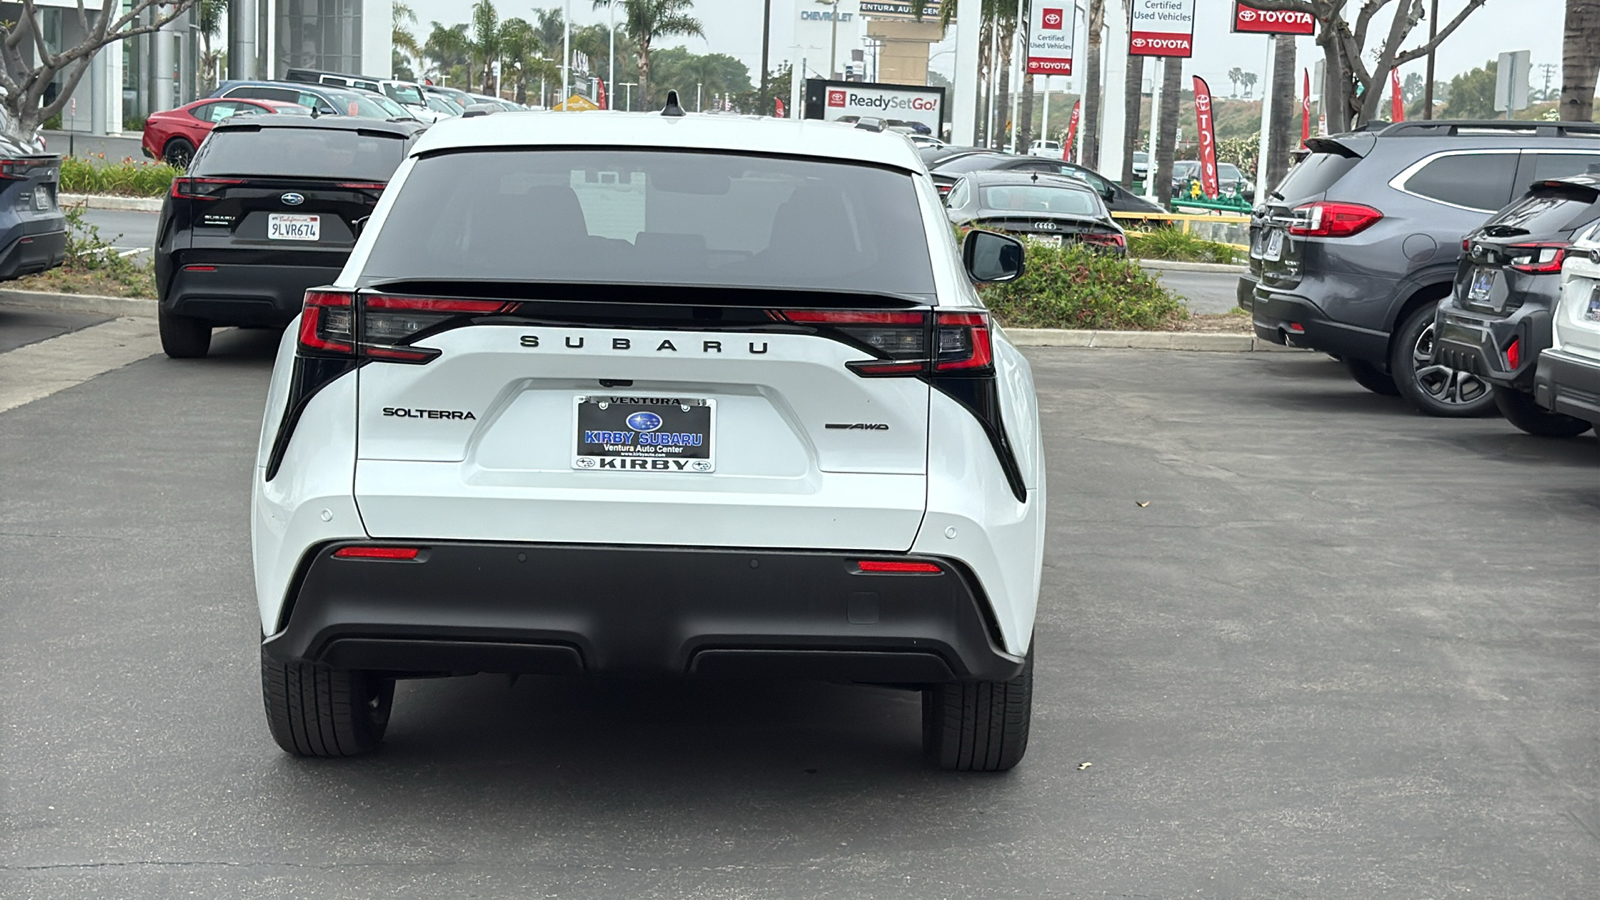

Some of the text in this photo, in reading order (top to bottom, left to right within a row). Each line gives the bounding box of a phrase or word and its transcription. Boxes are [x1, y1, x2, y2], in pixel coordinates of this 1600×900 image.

[1145, 0, 1182, 10] Certified
[1134, 11, 1191, 22] Used Vehicles
[1258, 10, 1312, 24] TOYOTA
[1037, 34, 1065, 42] Certified
[1147, 38, 1189, 49] TOYOTA
[1039, 61, 1071, 70] TOYOTA
[849, 93, 938, 111] ReadySetGo!
[272, 223, 316, 237] 9LVR674
[519, 335, 769, 354] SUBARU
[609, 396, 681, 406] VENTURA
[382, 407, 476, 420] SOLTERRA
[585, 430, 703, 447] KIRBY SUBARU
[603, 444, 684, 454] Ventura Auto Center
[600, 458, 689, 471] KIRBY
